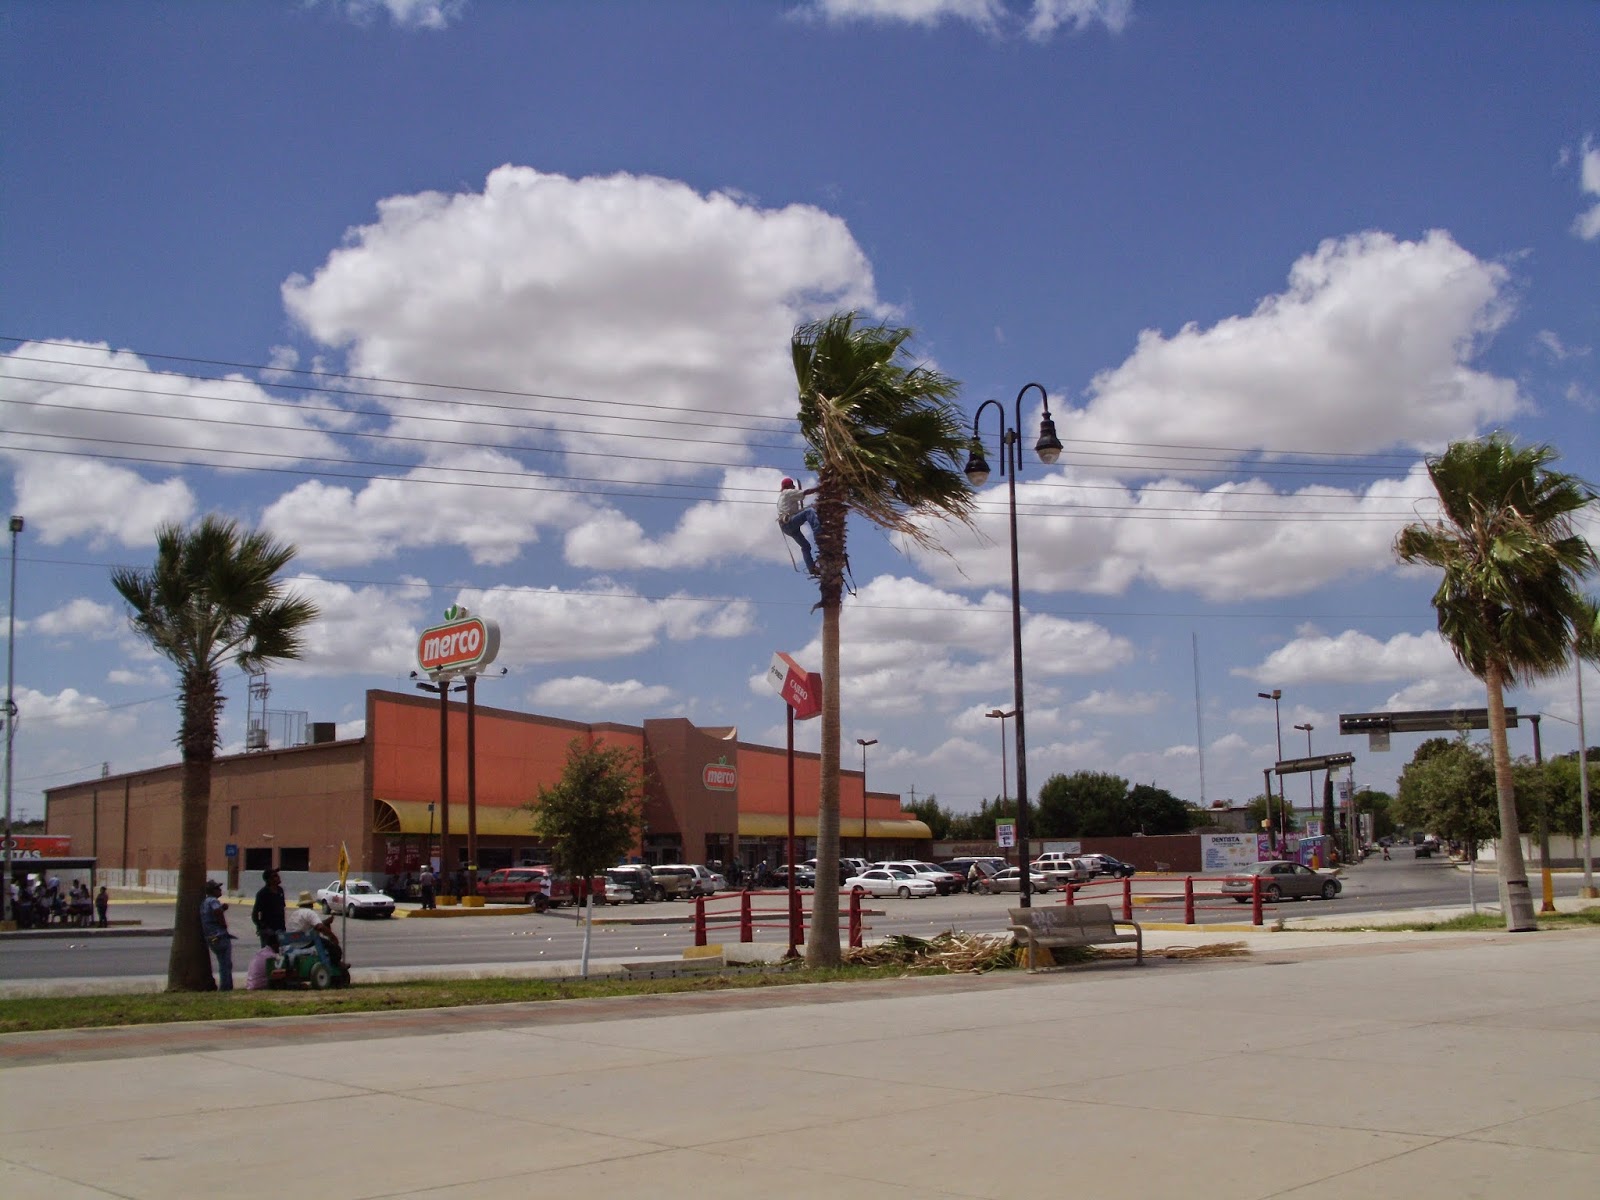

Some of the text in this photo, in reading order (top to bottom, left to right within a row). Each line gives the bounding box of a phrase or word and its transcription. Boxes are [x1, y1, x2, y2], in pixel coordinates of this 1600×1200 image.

[423, 628, 480, 661] merco
[790, 679, 808, 700] CAJERO
[707, 770, 734, 784] merco
